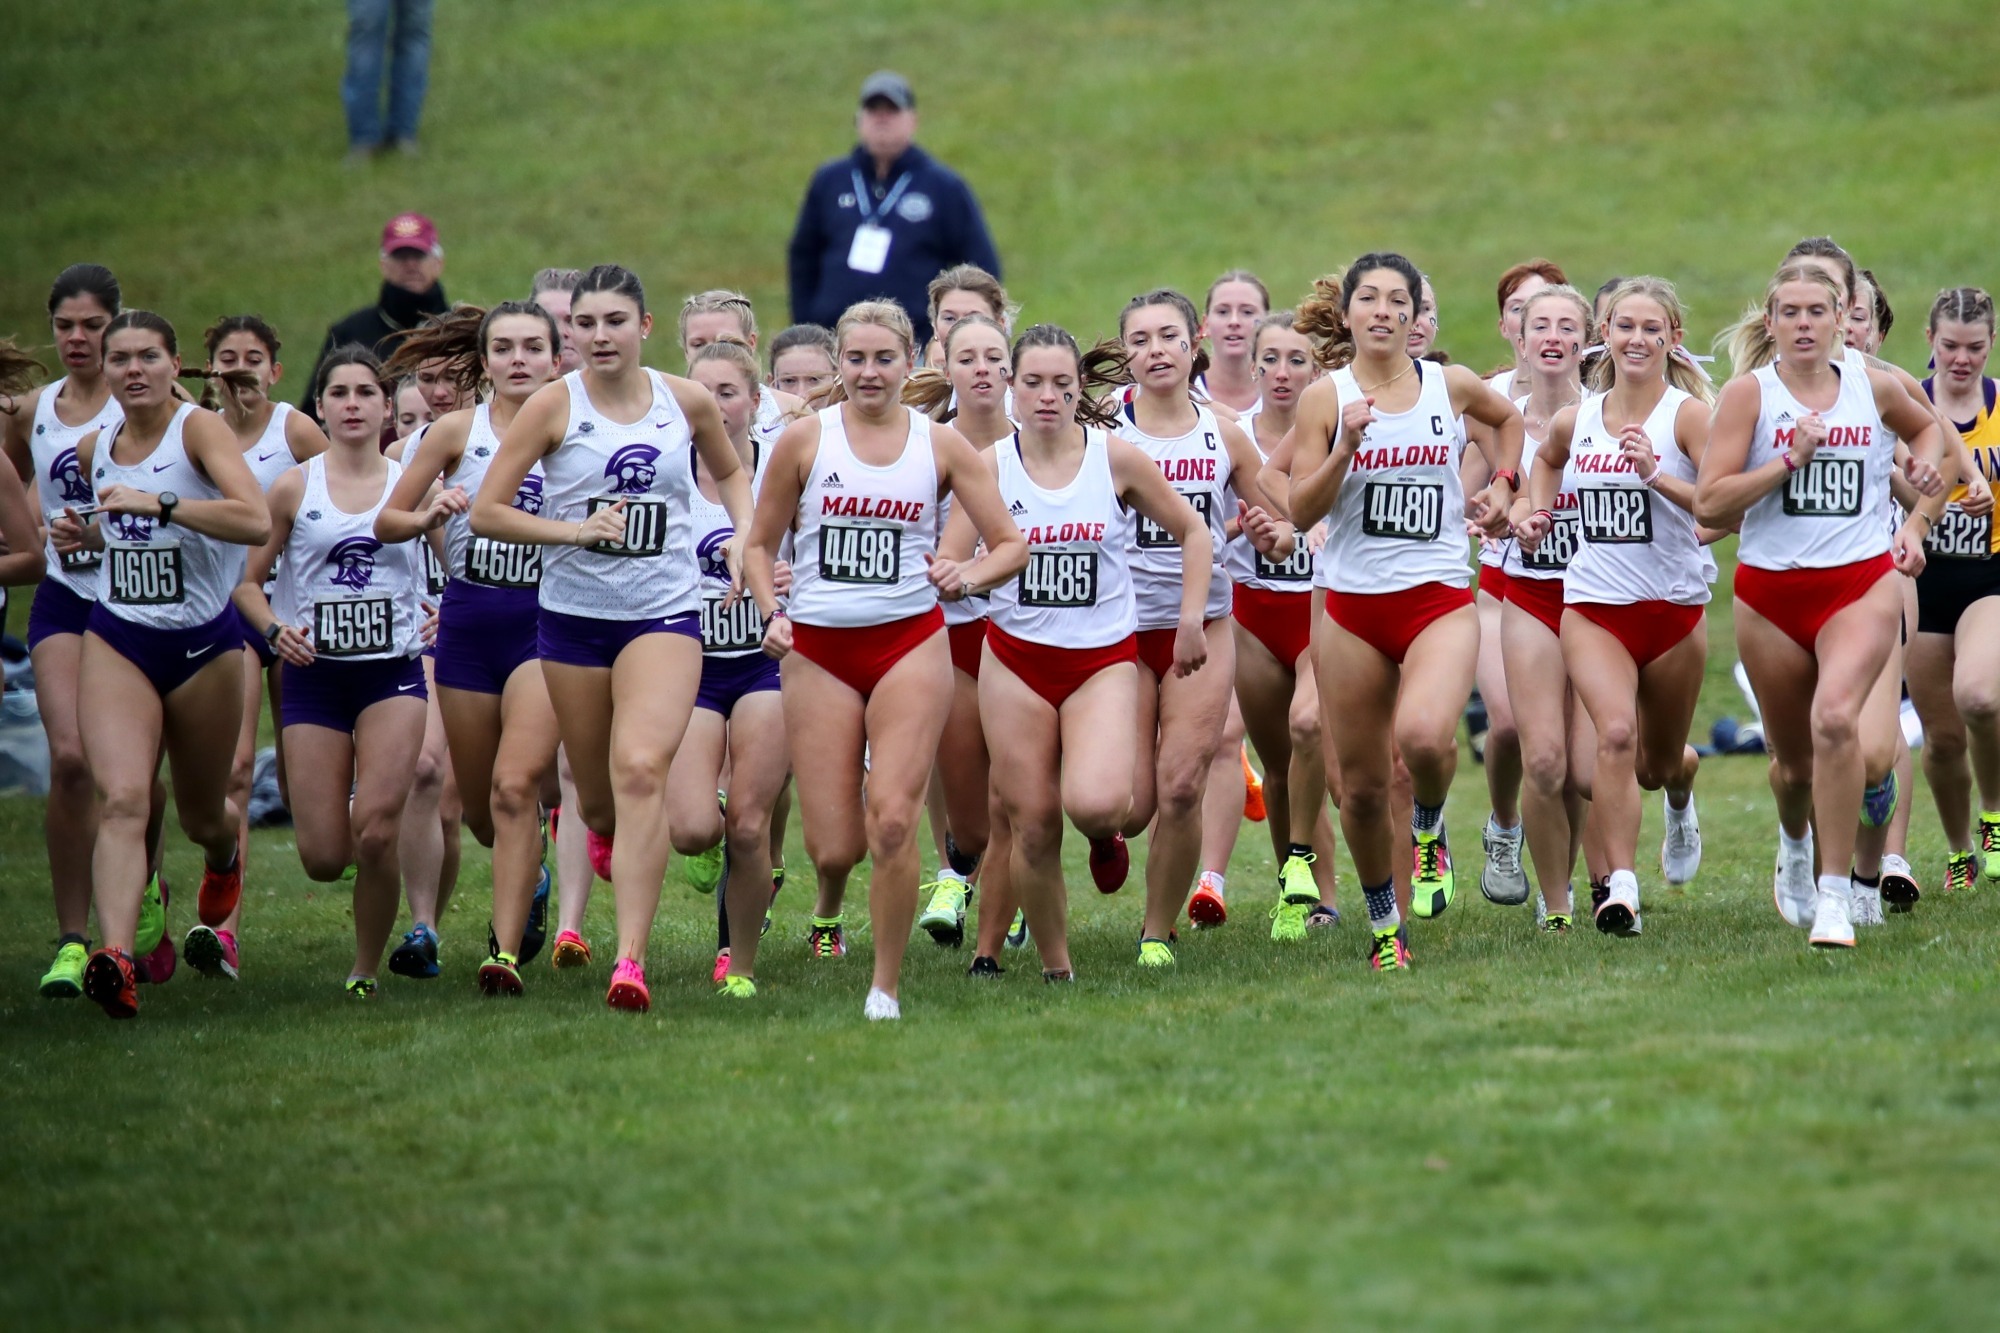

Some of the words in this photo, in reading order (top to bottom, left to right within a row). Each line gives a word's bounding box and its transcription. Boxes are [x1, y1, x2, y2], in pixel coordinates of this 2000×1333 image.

[1204, 432, 1216, 450] C
[1431, 415, 1443, 436] C
[1773, 426, 1871, 448] MONE
[1352, 445, 1449, 472] MALONE
[821, 481, 844, 489] adidas
[1789, 461, 1859, 511] 4499
[821, 496, 924, 522] MALONE
[1369, 485, 1438, 534] 4480
[1583, 490, 1647, 537] 4482
[824, 528, 895, 579] 4498
[1019, 523, 1105, 546] ALONE
[114, 550, 177, 598] 4605
[471, 537, 542, 583] 4602
[1024, 554, 1091, 601] 4485
[320, 601, 387, 649] 4595
[700, 598, 763, 645] 4604
